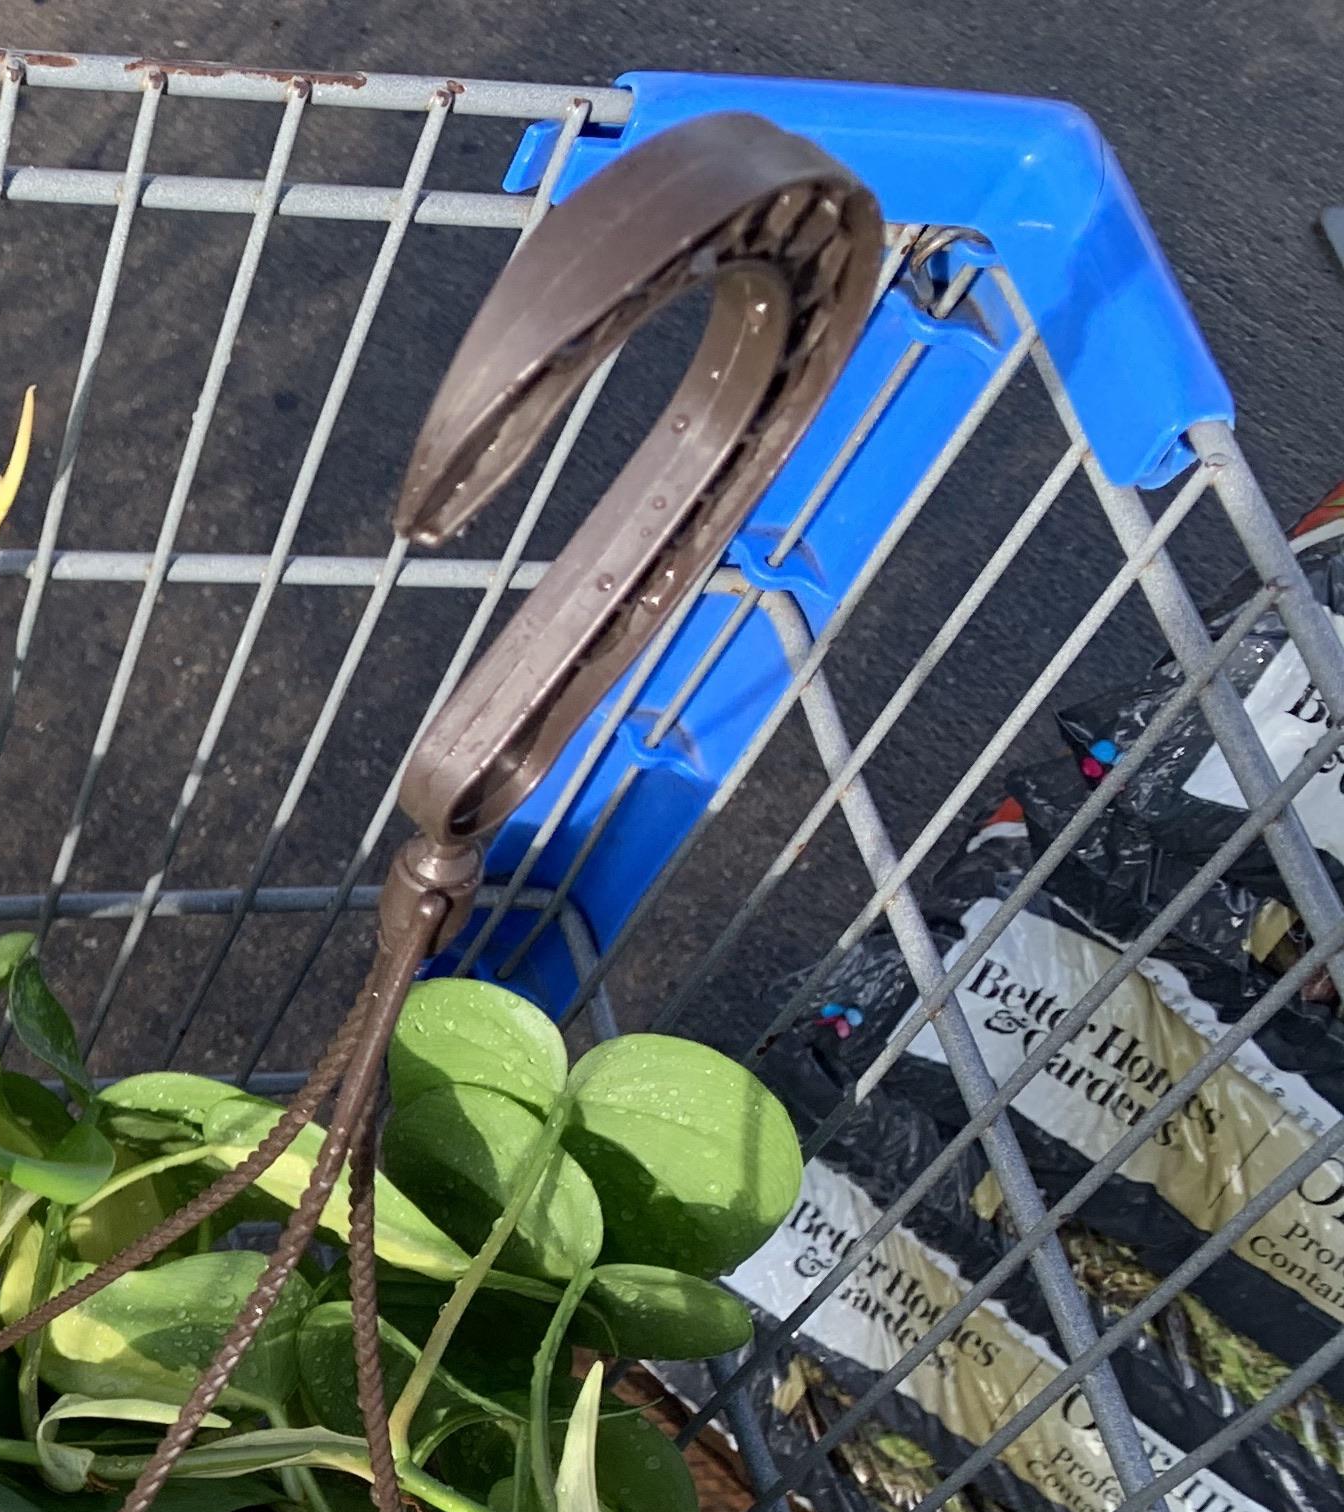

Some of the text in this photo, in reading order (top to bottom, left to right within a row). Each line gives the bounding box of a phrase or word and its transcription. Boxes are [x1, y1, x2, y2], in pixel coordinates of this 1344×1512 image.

[966, 958, 1098, 1045] Bette
[984, 1010, 1029, 1035] &
[792, 1246, 832, 1278] &
